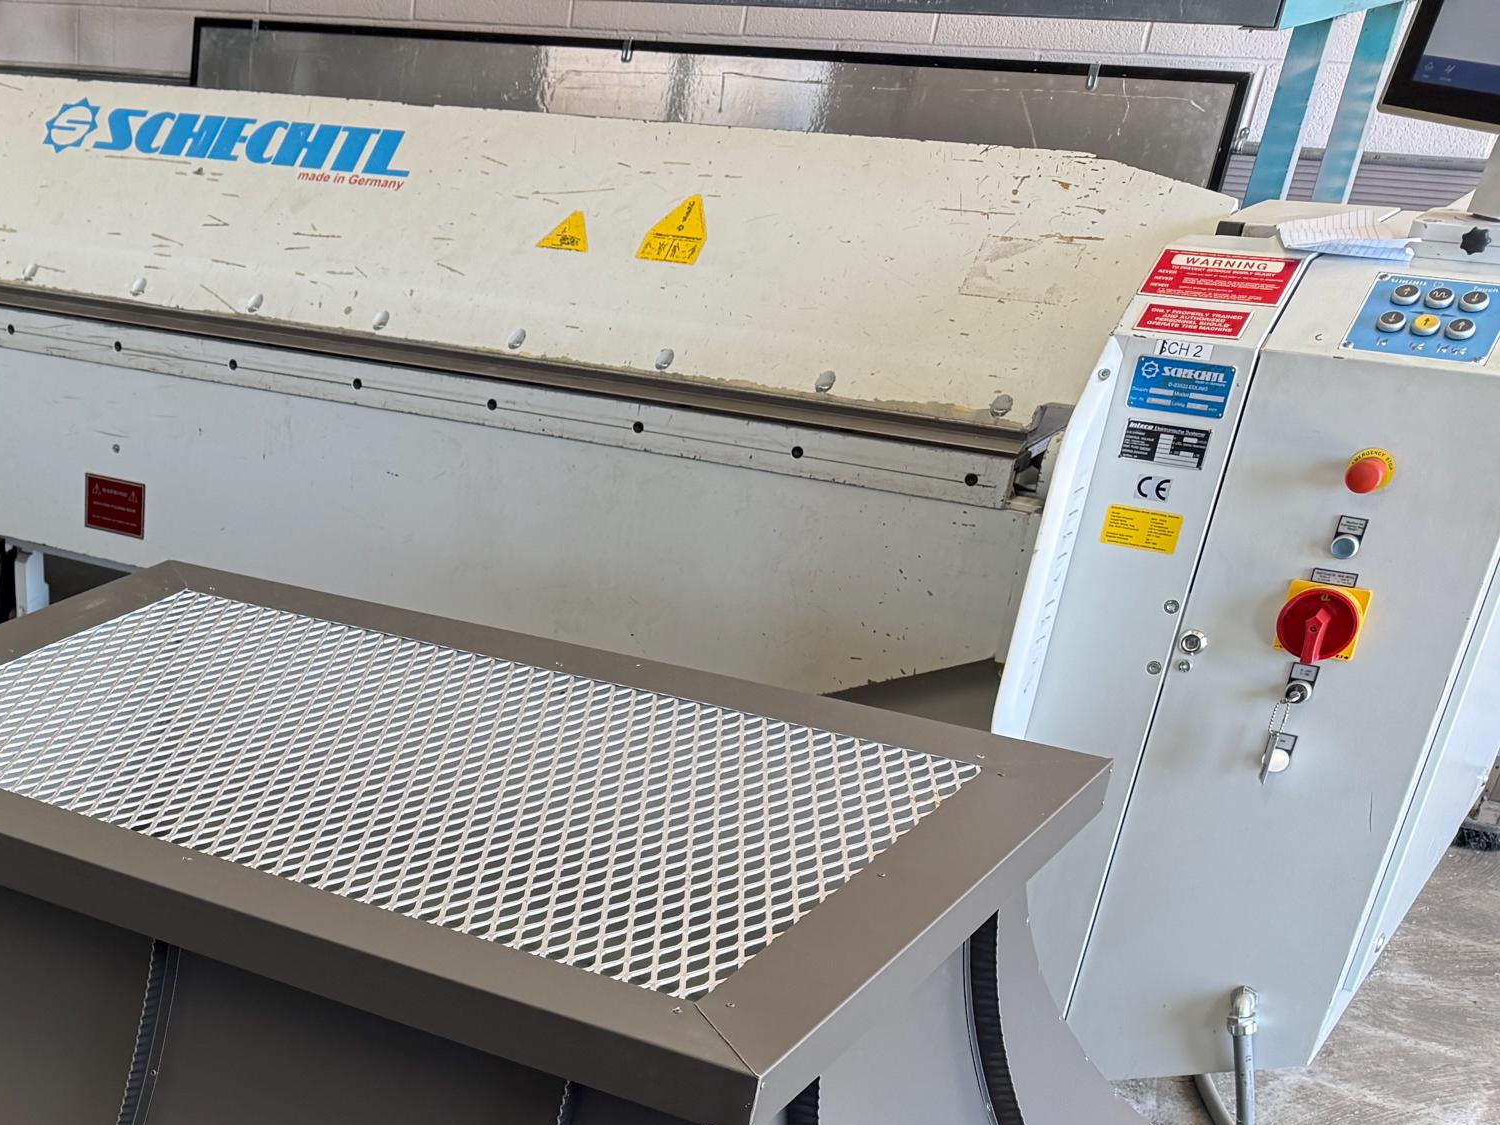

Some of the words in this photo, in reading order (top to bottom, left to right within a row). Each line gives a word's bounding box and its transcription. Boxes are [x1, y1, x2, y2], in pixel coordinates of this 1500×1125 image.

[92, 108, 410, 178] SCHECHTL
[297, 172, 331, 183] made
[333, 173, 345, 184] in
[348, 174, 405, 191] Germany
[1185, 256, 1268, 271] WARNING
[1171, 309, 1210, 317] PROPERLY
[1146, 320, 1180, 328] OPERATE
[1198, 325, 1233, 333] MACHINE
[1192, 345, 1203, 357] 2
